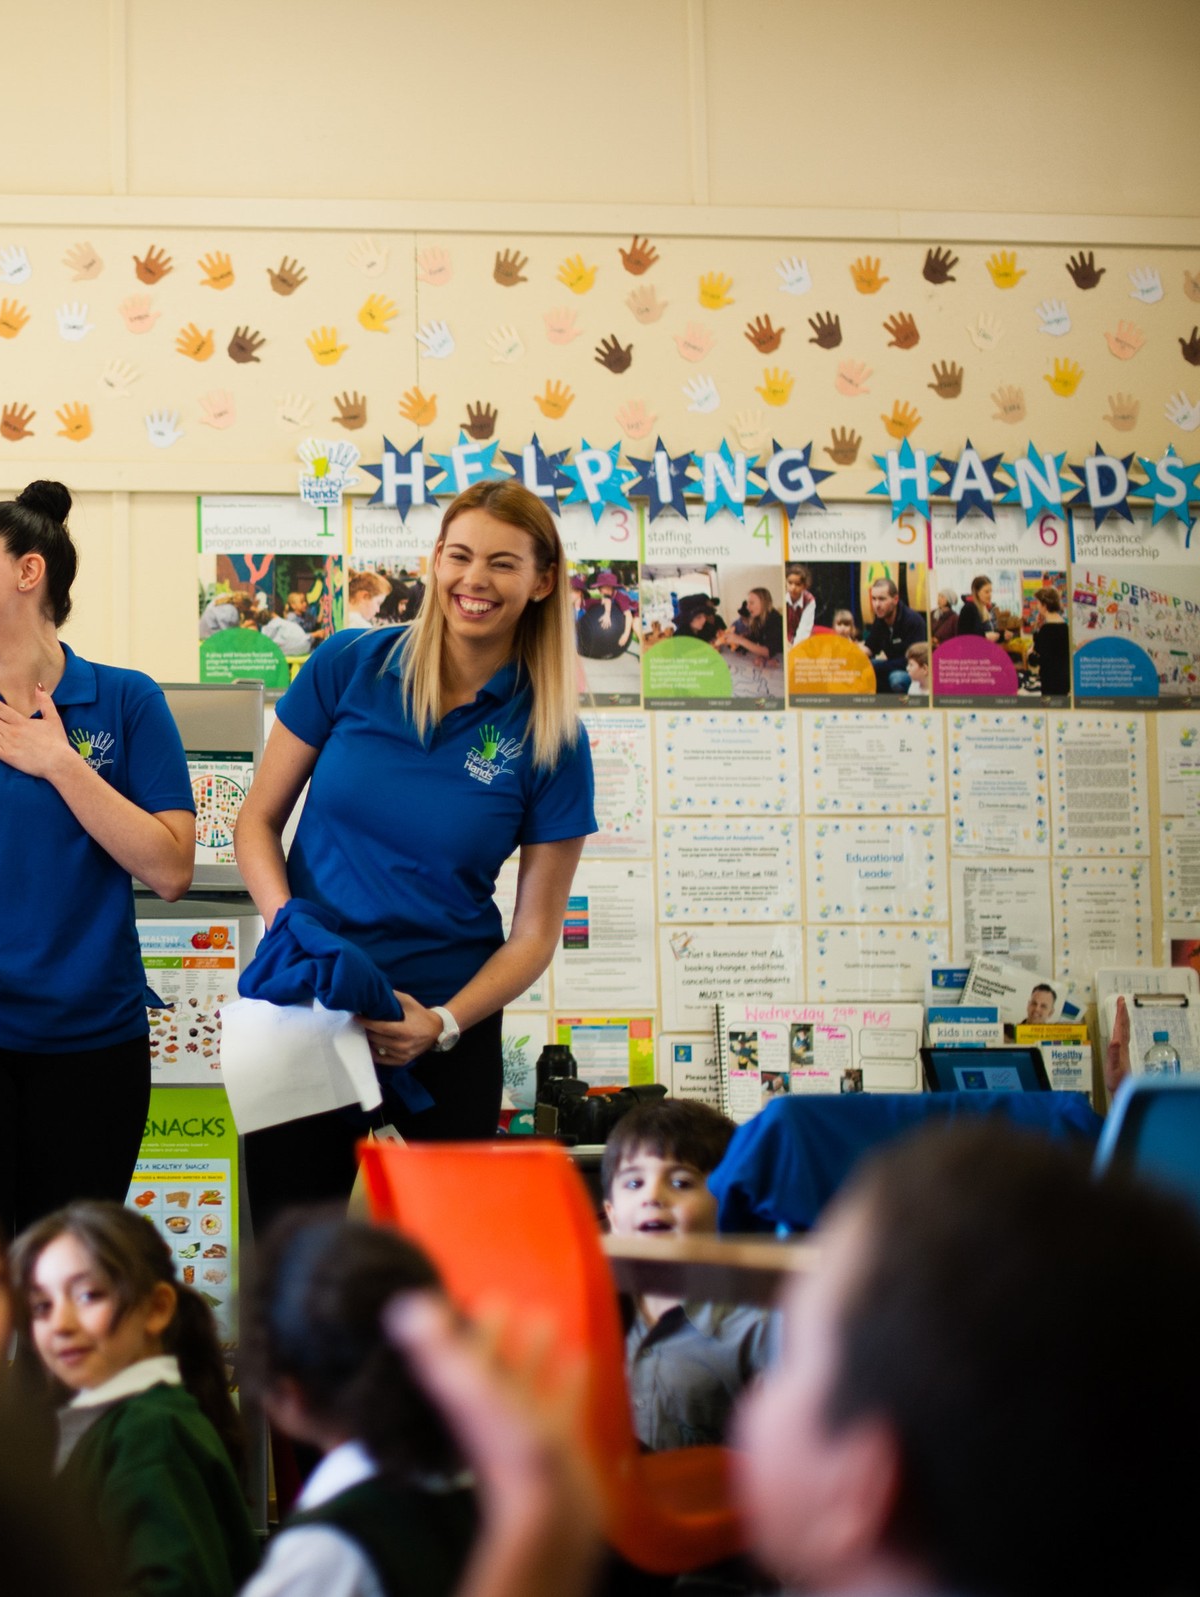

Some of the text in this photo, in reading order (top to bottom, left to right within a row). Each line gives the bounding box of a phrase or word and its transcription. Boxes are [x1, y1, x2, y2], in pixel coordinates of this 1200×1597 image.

[382, 443, 1189, 509] HELPING HANDS
[303, 488, 339, 499] Hands
[316, 506, 335, 537] 1
[609, 509, 630, 542] 3
[204, 524, 271, 536] educational
[354, 524, 412, 535] children's
[752, 514, 773, 547] 4
[897, 512, 917, 545] 5
[1039, 514, 1058, 547] 6
[1177, 516, 1198, 549] 7
[648, 530, 692, 544] staffing
[791, 529, 867, 542] relationships
[934, 530, 997, 540] collaborative
[1077, 533, 1142, 545] governance
[204, 536, 324, 550] program and practice
[354, 537, 394, 549] health
[397, 537, 420, 549] and
[791, 542, 867, 554] with children
[934, 542, 1019, 554] partnerships with
[648, 546, 731, 558] arrangements
[1077, 546, 1160, 560] and leadership
[935, 556, 1057, 567] families and communities
[463, 759, 494, 781] Hands
[846, 853, 905, 864] Educational
[858, 869, 893, 879] Leader
[712, 950, 748, 958] Reminder
[751, 950, 767, 958] that
[769, 950, 785, 959] ALL
[684, 964, 714, 974] booking
[681, 977, 731, 986] cancellations
[743, 976, 790, 985] amendments
[699, 990, 723, 1000] MUST
[725, 990, 735, 998] be
[746, 990, 773, 998] writing
[744, 1005, 825, 1026] Wednesday
[937, 1027, 999, 1038] kids in care
[1051, 1050, 1083, 1061] Healthy
[1051, 1068, 1082, 1076] children
